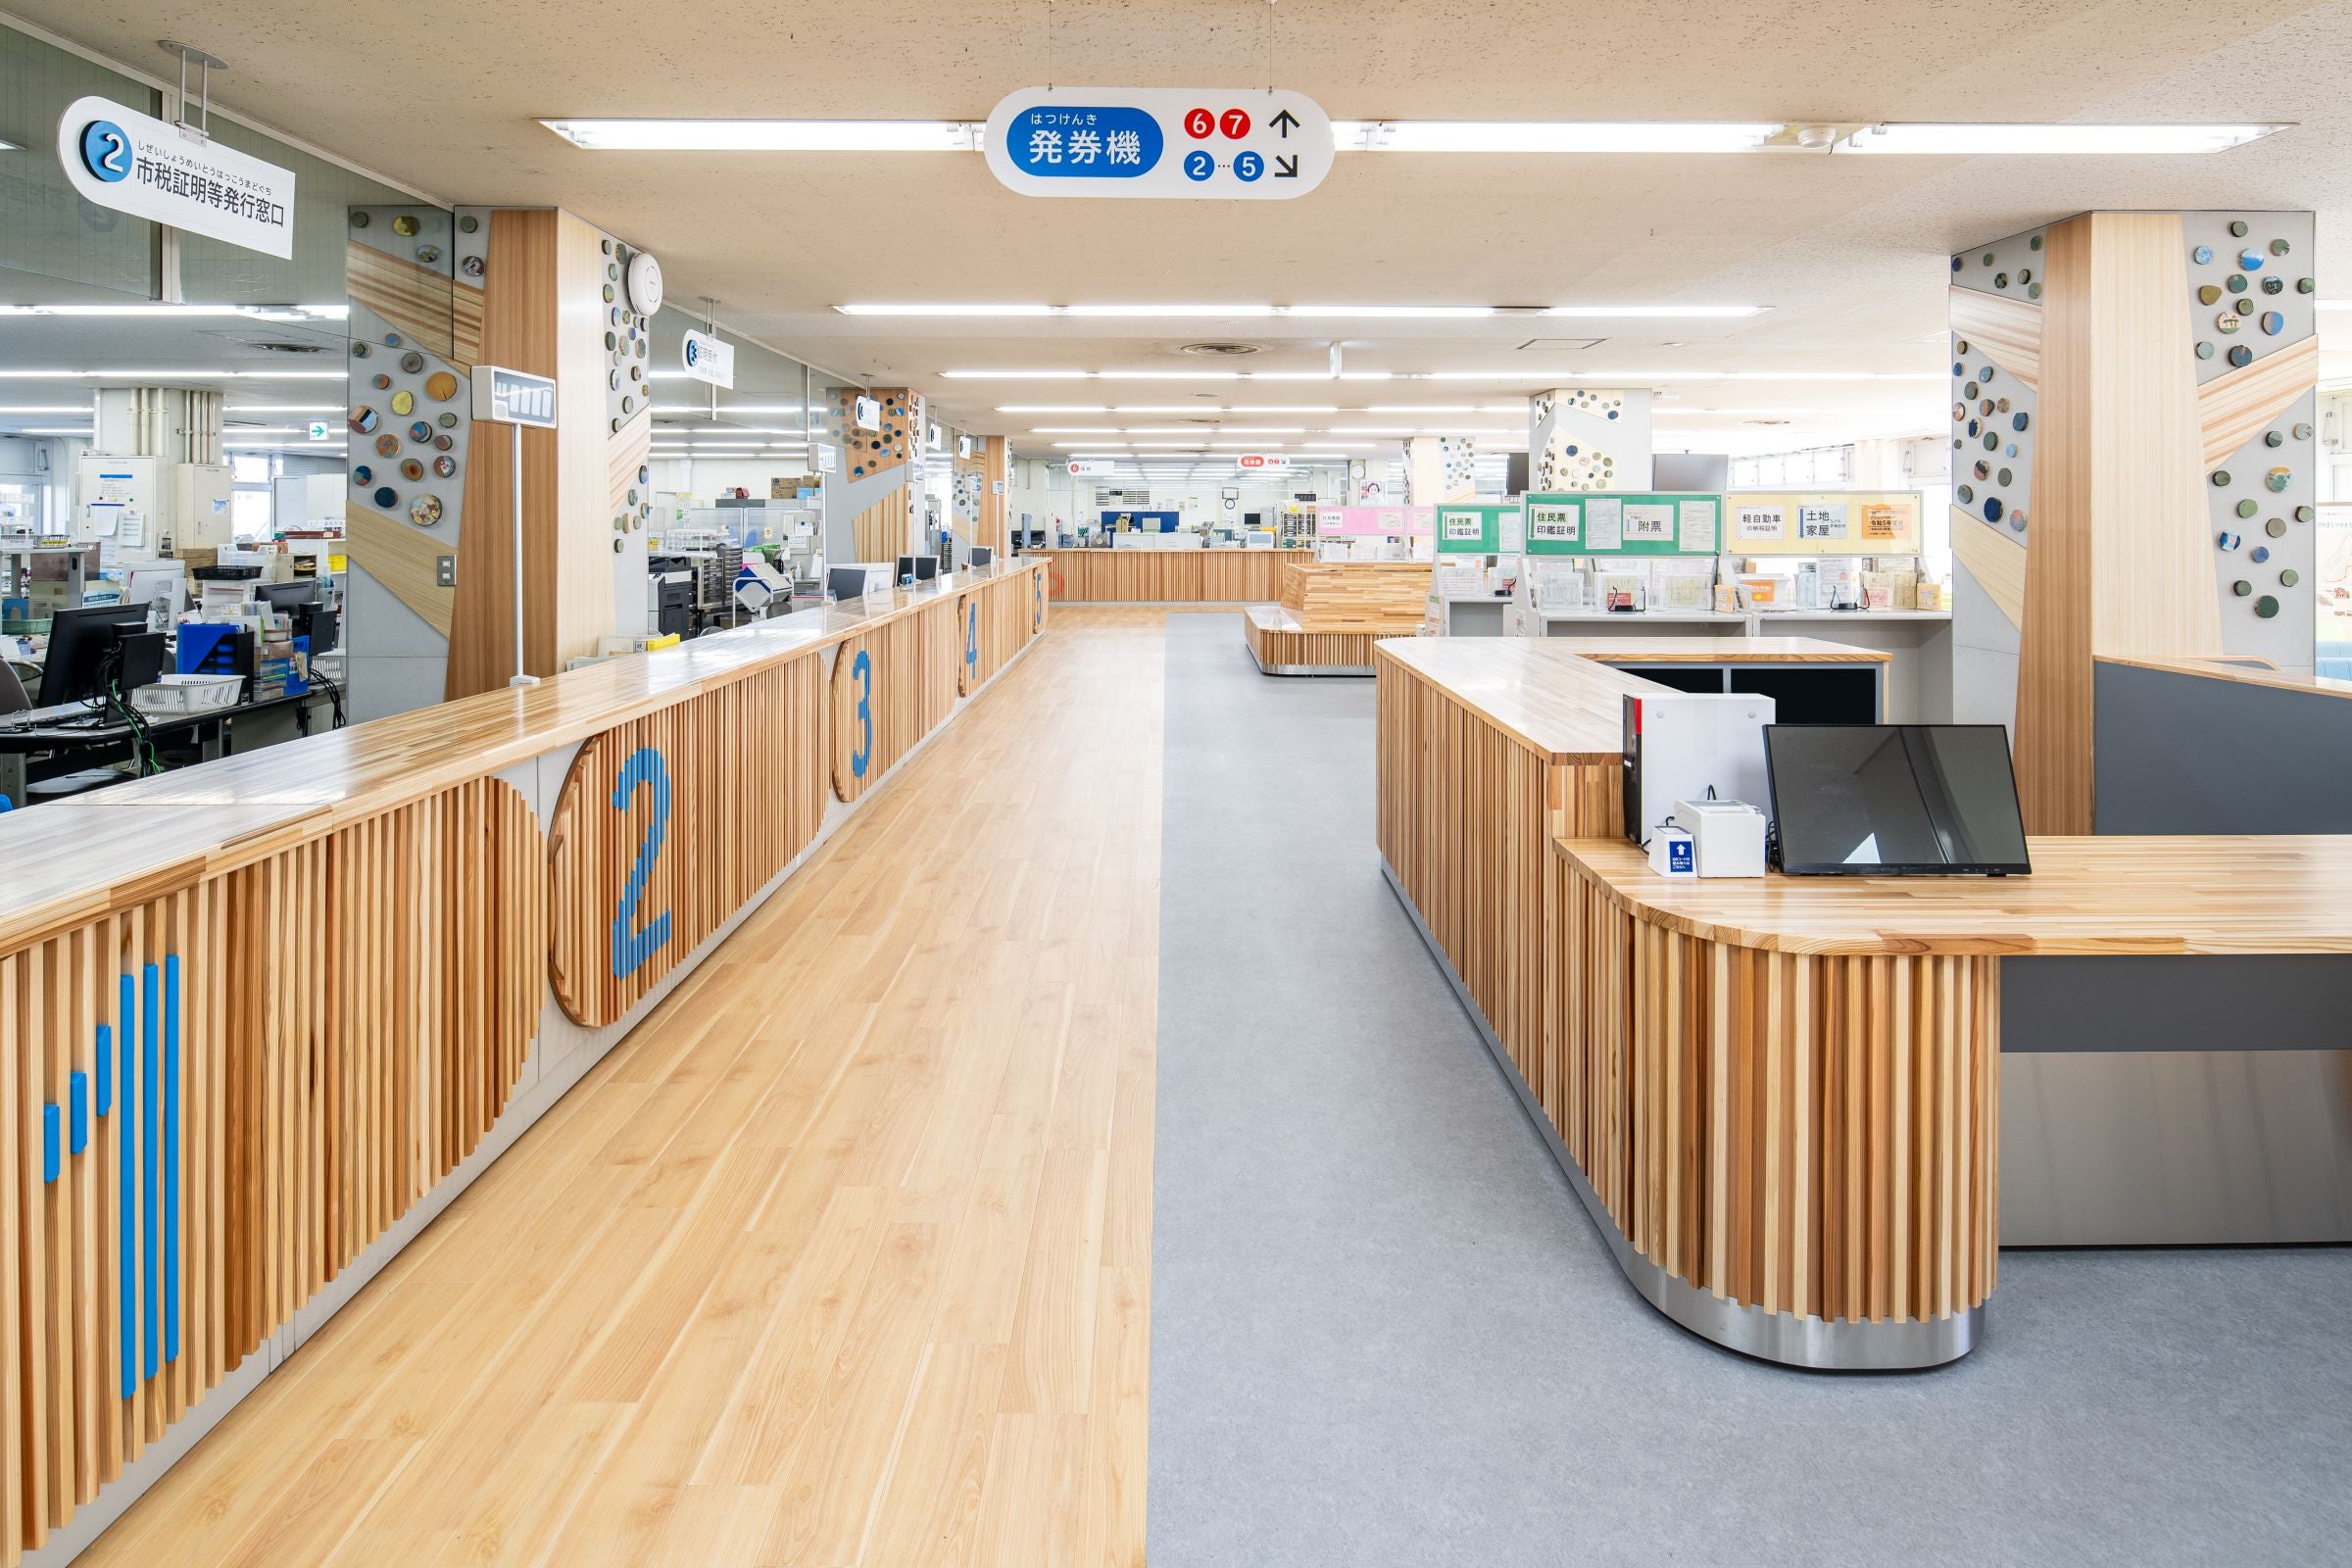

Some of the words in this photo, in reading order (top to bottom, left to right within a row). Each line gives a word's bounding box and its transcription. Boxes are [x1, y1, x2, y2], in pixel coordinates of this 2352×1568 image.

[1030, 113, 1098, 127] はつけんき
[1192, 114, 1207, 134] 6
[1228, 115, 1243, 135] 7
[104, 132, 123, 172] 2
[1028, 128, 1142, 166] 発券機
[137, 140, 272, 196] しぜいしょうめいとうはっこうまどぐち
[1192, 156, 1207, 175] 2
[1241, 156, 1256, 175] 5
[135, 157, 285, 228] 市税証明等発行窓口
[1448, 517, 1472, 526] 住民票
[1537, 512, 1567, 522] 住民票
[1741, 514, 1782, 524] 軽自動車
[1806, 510, 1830, 521] 土地
[1448, 527, 1480, 536] 印鑑証明
[1537, 524, 1576, 536] 印鑑証明
[1638, 519, 1662, 532] 附票
[1806, 524, 1830, 536] 家屋
[1037, 572, 1041, 625] 5
[965, 602, 978, 680] 4
[851, 649, 872, 778] 3
[612, 747, 672, 981] 2
